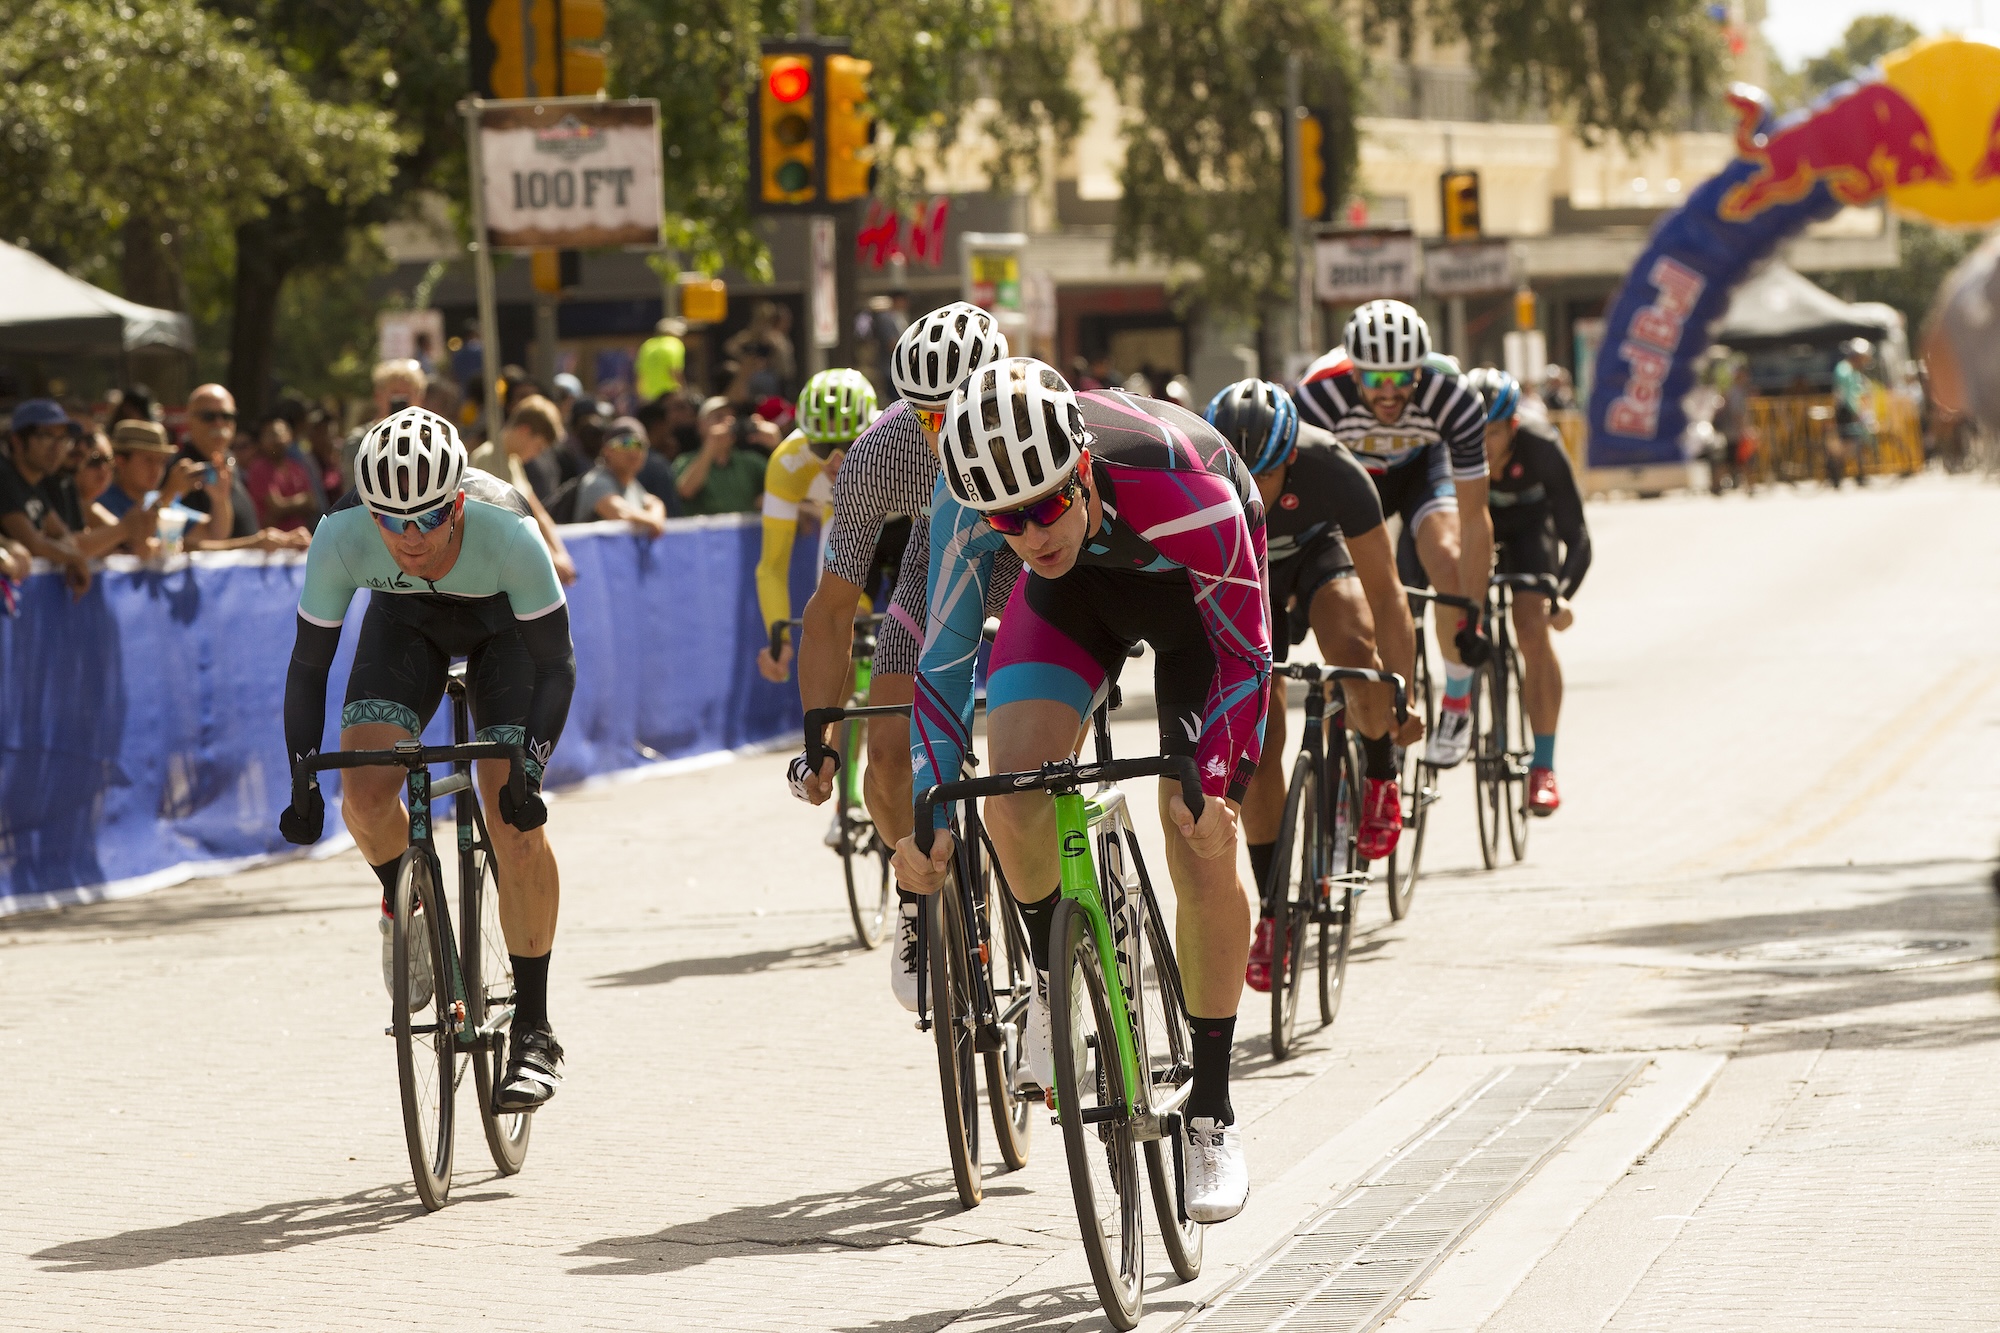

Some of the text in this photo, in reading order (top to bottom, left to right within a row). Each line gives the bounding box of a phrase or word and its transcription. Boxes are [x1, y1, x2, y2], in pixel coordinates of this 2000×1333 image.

[512, 166, 635, 209] 100 FT
[856, 198, 950, 271] HM
[1604, 254, 1706, 440] Red Bull
